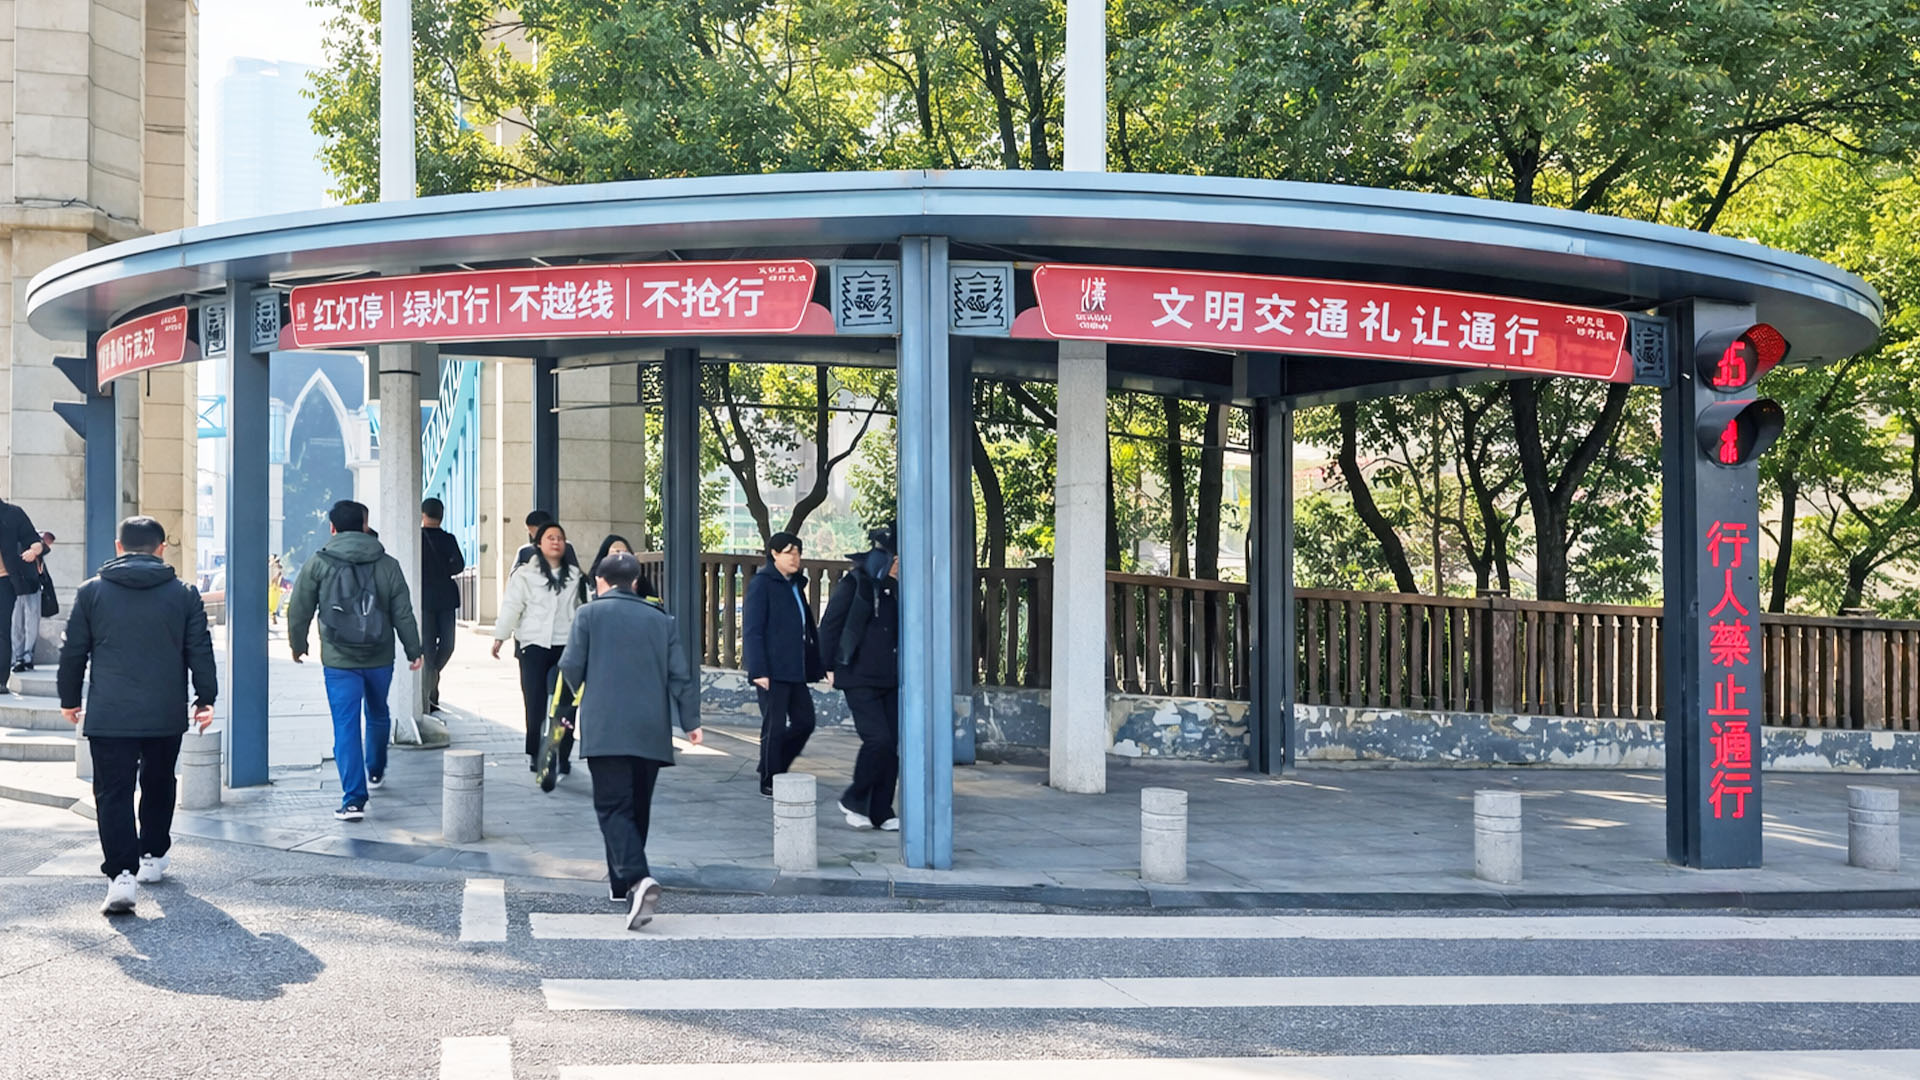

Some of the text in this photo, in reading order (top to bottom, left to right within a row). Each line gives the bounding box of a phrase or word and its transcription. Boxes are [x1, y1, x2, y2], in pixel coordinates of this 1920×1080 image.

[313, 292, 384, 332] 红灯停
[402, 285, 489, 328] 绿灯行
[509, 280, 613, 322] 不越线
[642, 277, 764, 318] 不抢行
[1152, 286, 1540, 357] 文明交通礼让通行
[1707, 521, 1752, 818] 行人禁止通行
